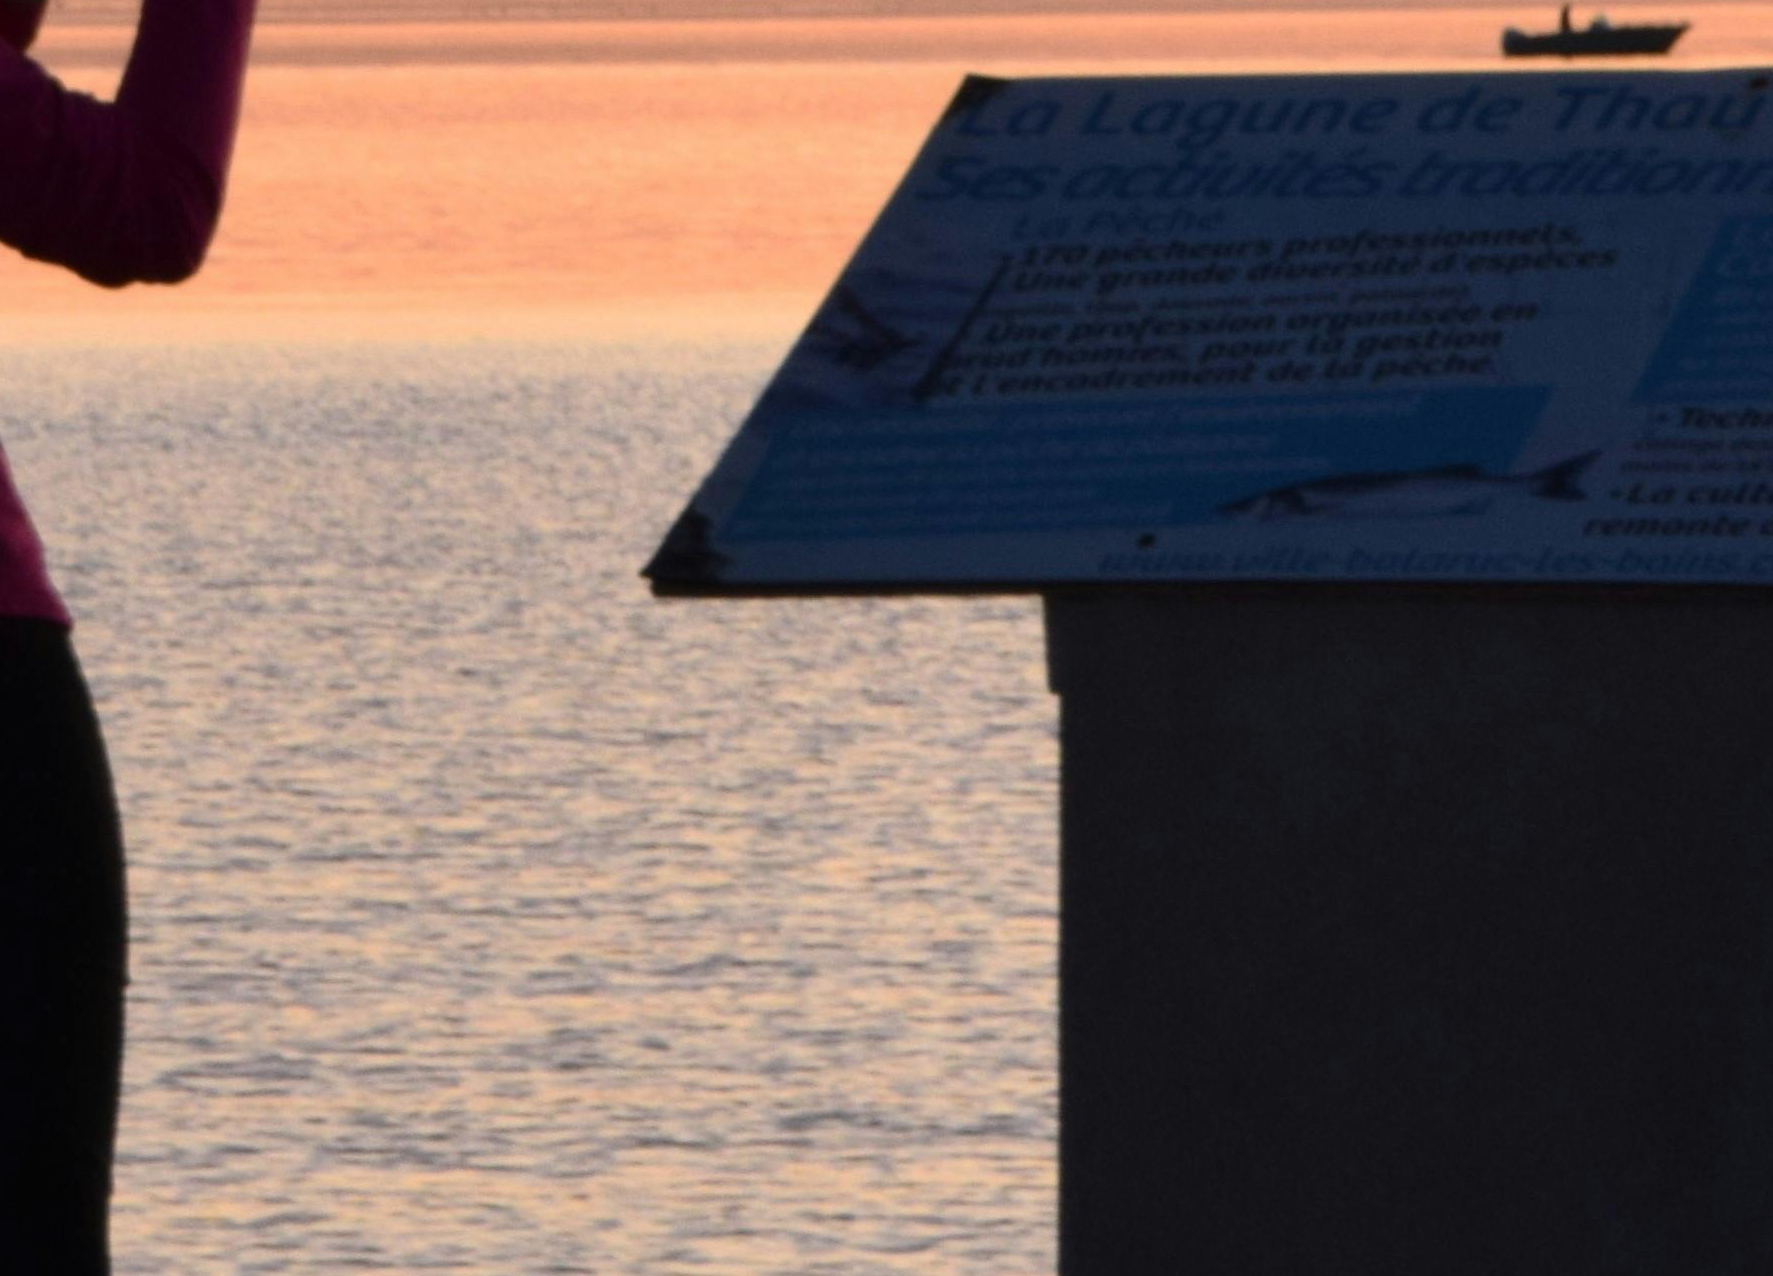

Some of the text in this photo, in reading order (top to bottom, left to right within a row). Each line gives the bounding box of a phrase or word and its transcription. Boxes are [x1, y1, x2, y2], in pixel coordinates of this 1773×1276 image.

[957, 93, 1062, 137] La
[1080, 89, 1400, 151] Lagune
[1416, 84, 1524, 134] de
[915, 154, 1062, 201] Ses
[1062, 147, 1397, 200] activités
[1093, 237, 1273, 268] pêcheurs
[1012, 271, 1088, 293] Une
[1095, 263, 1238, 296] grande
[1244, 255, 1421, 282] diversité
[985, 304, 1540, 346] Une profession organisée en
[1198, 340, 1297, 364] pour
[1303, 334, 1346, 356] la
[1352, 329, 1504, 360] gestion
[1263, 360, 1316, 383] de
[1322, 358, 1365, 381] la
[1626, 483, 1677, 506] La
[1581, 515, 1753, 537] remonte
